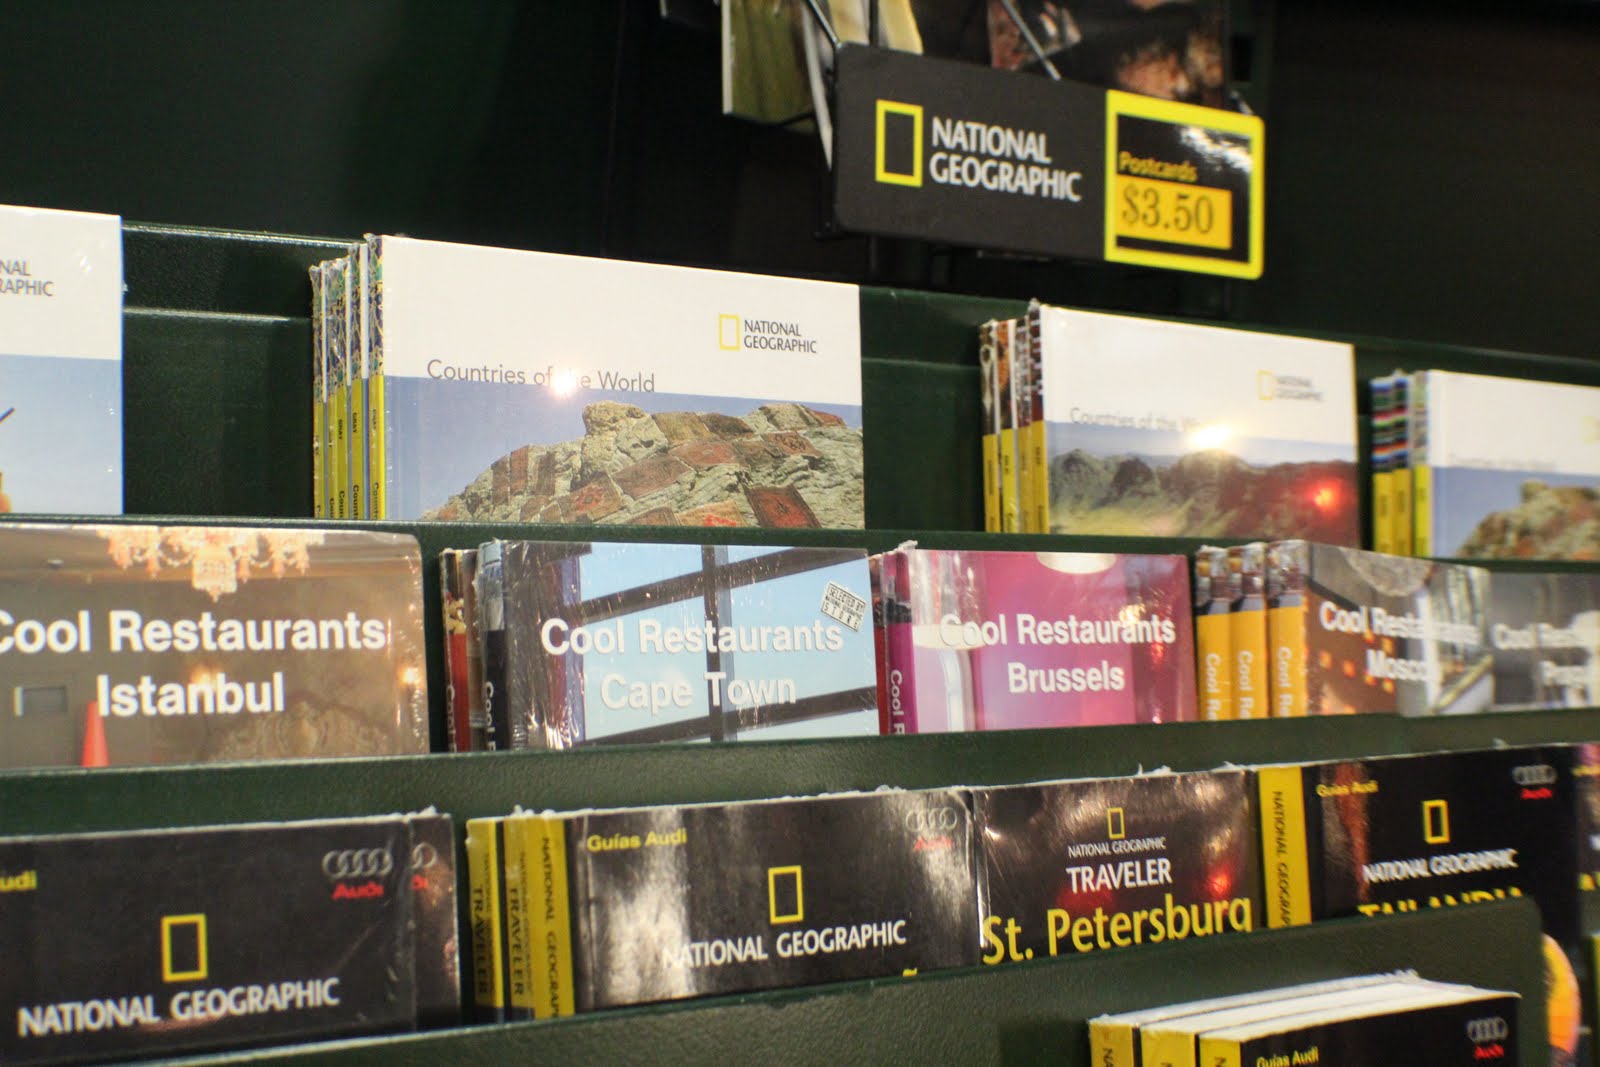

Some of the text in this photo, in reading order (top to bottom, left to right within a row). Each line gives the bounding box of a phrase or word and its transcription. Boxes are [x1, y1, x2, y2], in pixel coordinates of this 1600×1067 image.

[931, 116, 1052, 164] NATIONAL
[929, 152, 1082, 202] GEOGRAPHIC
[1119, 151, 1198, 183] Postcards
[1122, 184, 1213, 234] $3.50
[744, 319, 803, 337] NATIONAL
[744, 335, 817, 354] GEOGRAPHIC
[427, 359, 526, 385] Countries
[533, 366, 554, 389] of
[598, 371, 655, 393] World
[108, 610, 387, 653] Restaurants
[541, 618, 845, 656] Cool Restaurants
[940, 613, 1177, 647] Cool Restaurants
[1319, 600, 1369, 634] Cool
[1007, 660, 1126, 694] Brussels
[1206, 653, 1221, 693] Cool
[1239, 650, 1254, 691] Cool
[1278, 646, 1292, 688] Cool
[97, 671, 285, 717] Istanbul
[485, 681, 496, 733] Cool
[601, 671, 798, 715] Cape Town
[890, 669, 905, 716] Cool
[586, 827, 688, 853] Guías Audi
[1272, 790, 1288, 858] NATIONAL
[1068, 836, 1167, 859] NATIONAL GEOGRAPHIC
[1362, 848, 1519, 885] NATIONAL GEOGRAPHIC
[331, 881, 384, 900] Audi
[542, 837, 555, 921] NATIONAL
[1065, 858, 1173, 894] TRAVELER
[473, 884, 488, 994] TRAVELER
[509, 886, 524, 995] TRAVELER
[663, 919, 907, 970] NATIONAL GEOGRAPHIC
[981, 915, 1034, 966] St.
[17, 976, 341, 1038] NATIONAL GEOGRAPHIC
